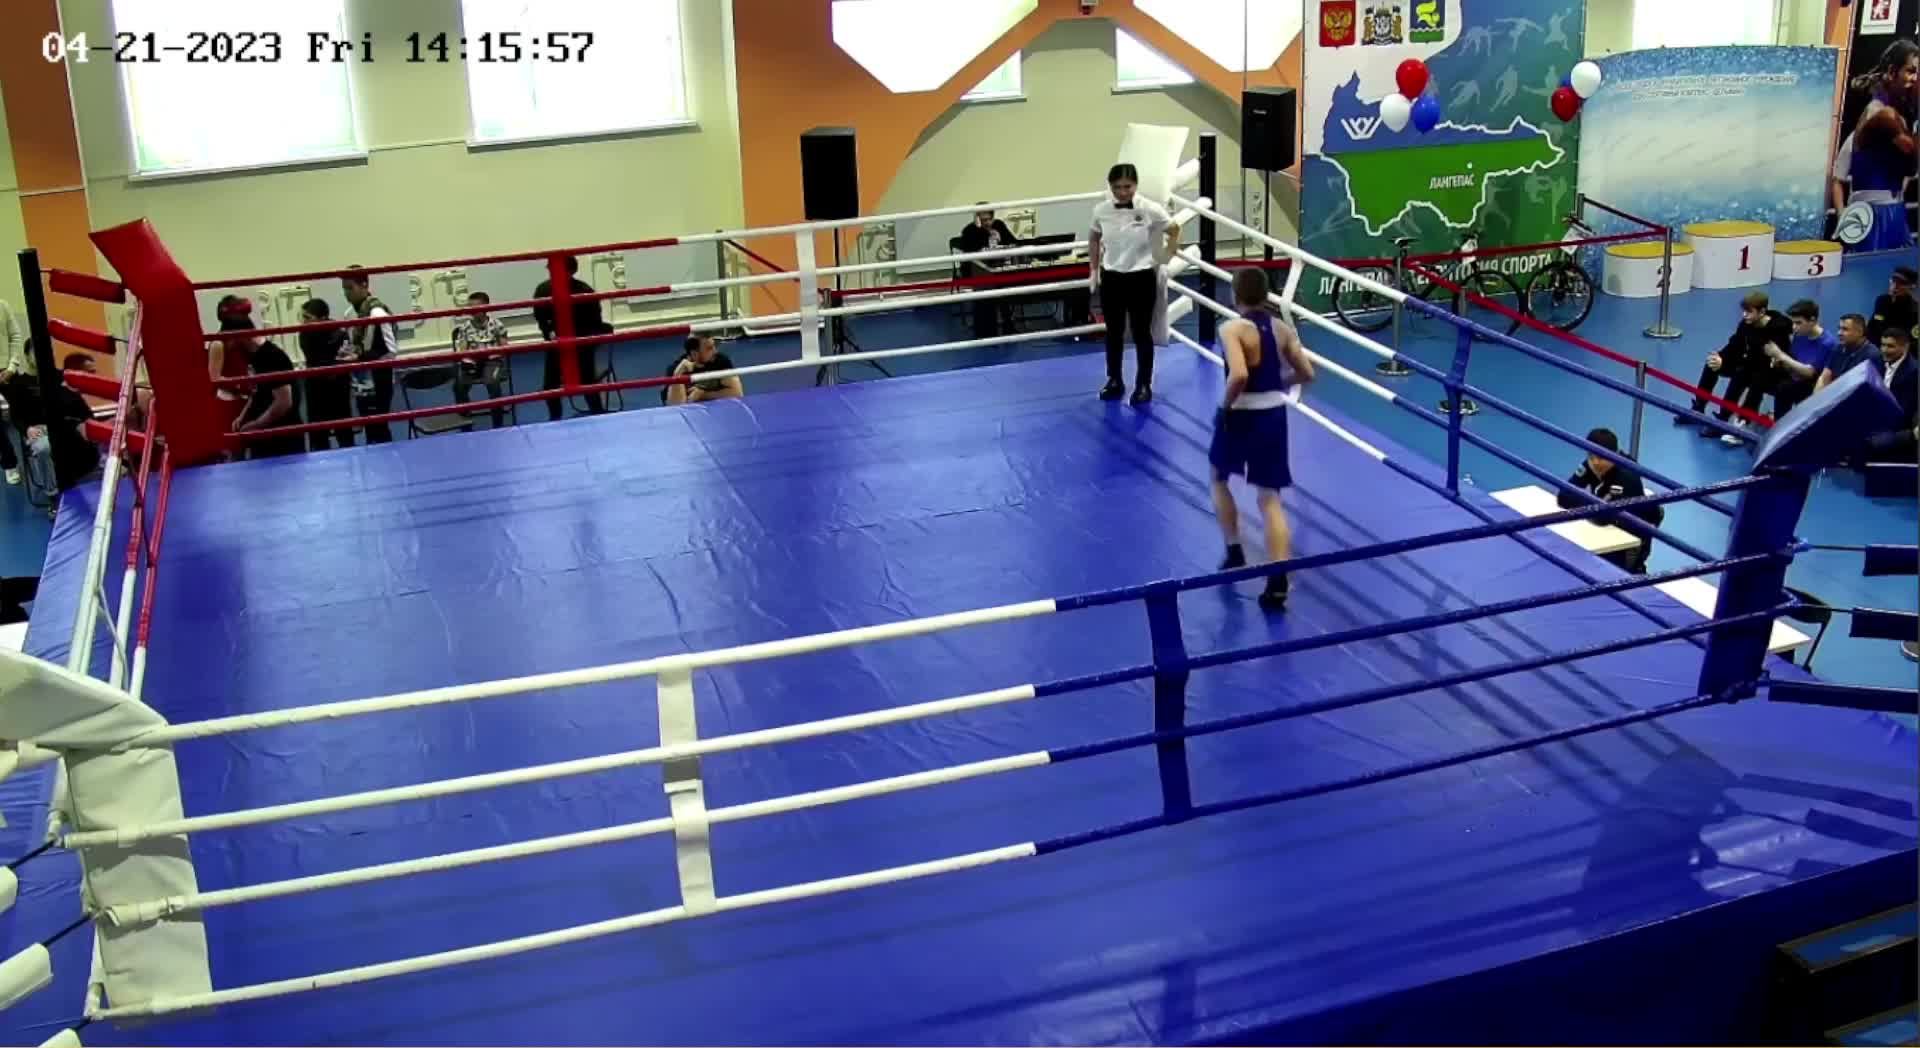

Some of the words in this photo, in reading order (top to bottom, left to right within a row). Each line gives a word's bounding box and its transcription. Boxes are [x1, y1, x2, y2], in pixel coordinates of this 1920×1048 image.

[1429, 174, 1474, 190] ЛАНГЕПАС
[1501, 253, 1553, 275] СПОРТА
[1737, 245, 1750, 271] 1
[1807, 254, 1824, 276] 3
